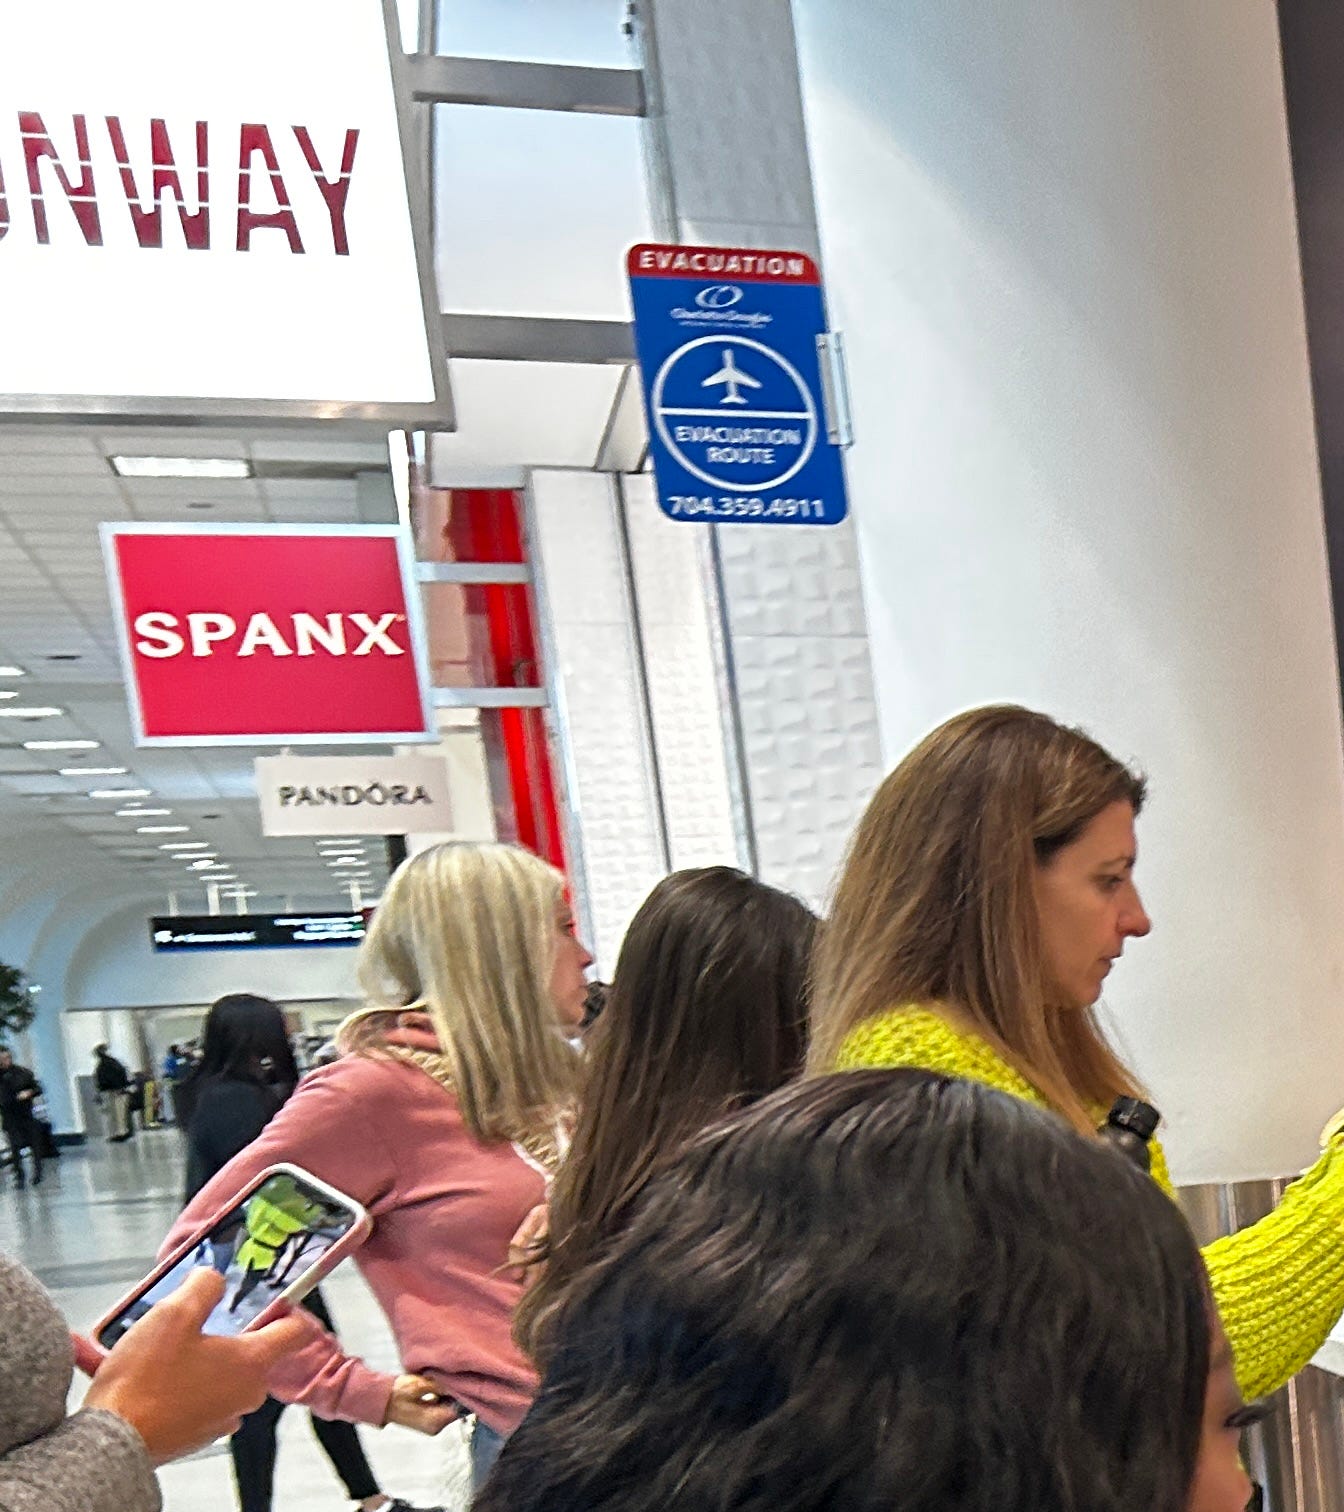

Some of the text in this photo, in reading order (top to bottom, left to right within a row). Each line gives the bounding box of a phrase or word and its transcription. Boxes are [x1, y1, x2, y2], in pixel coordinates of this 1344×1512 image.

[0, 111, 361, 256] NWAY
[638, 250, 805, 277] EVACUATION
[674, 425, 802, 446] EVACUATION
[705, 446, 776, 465] ROUTE
[666, 495, 826, 518] 704.359.4911
[136, 611, 404, 659] SPANX
